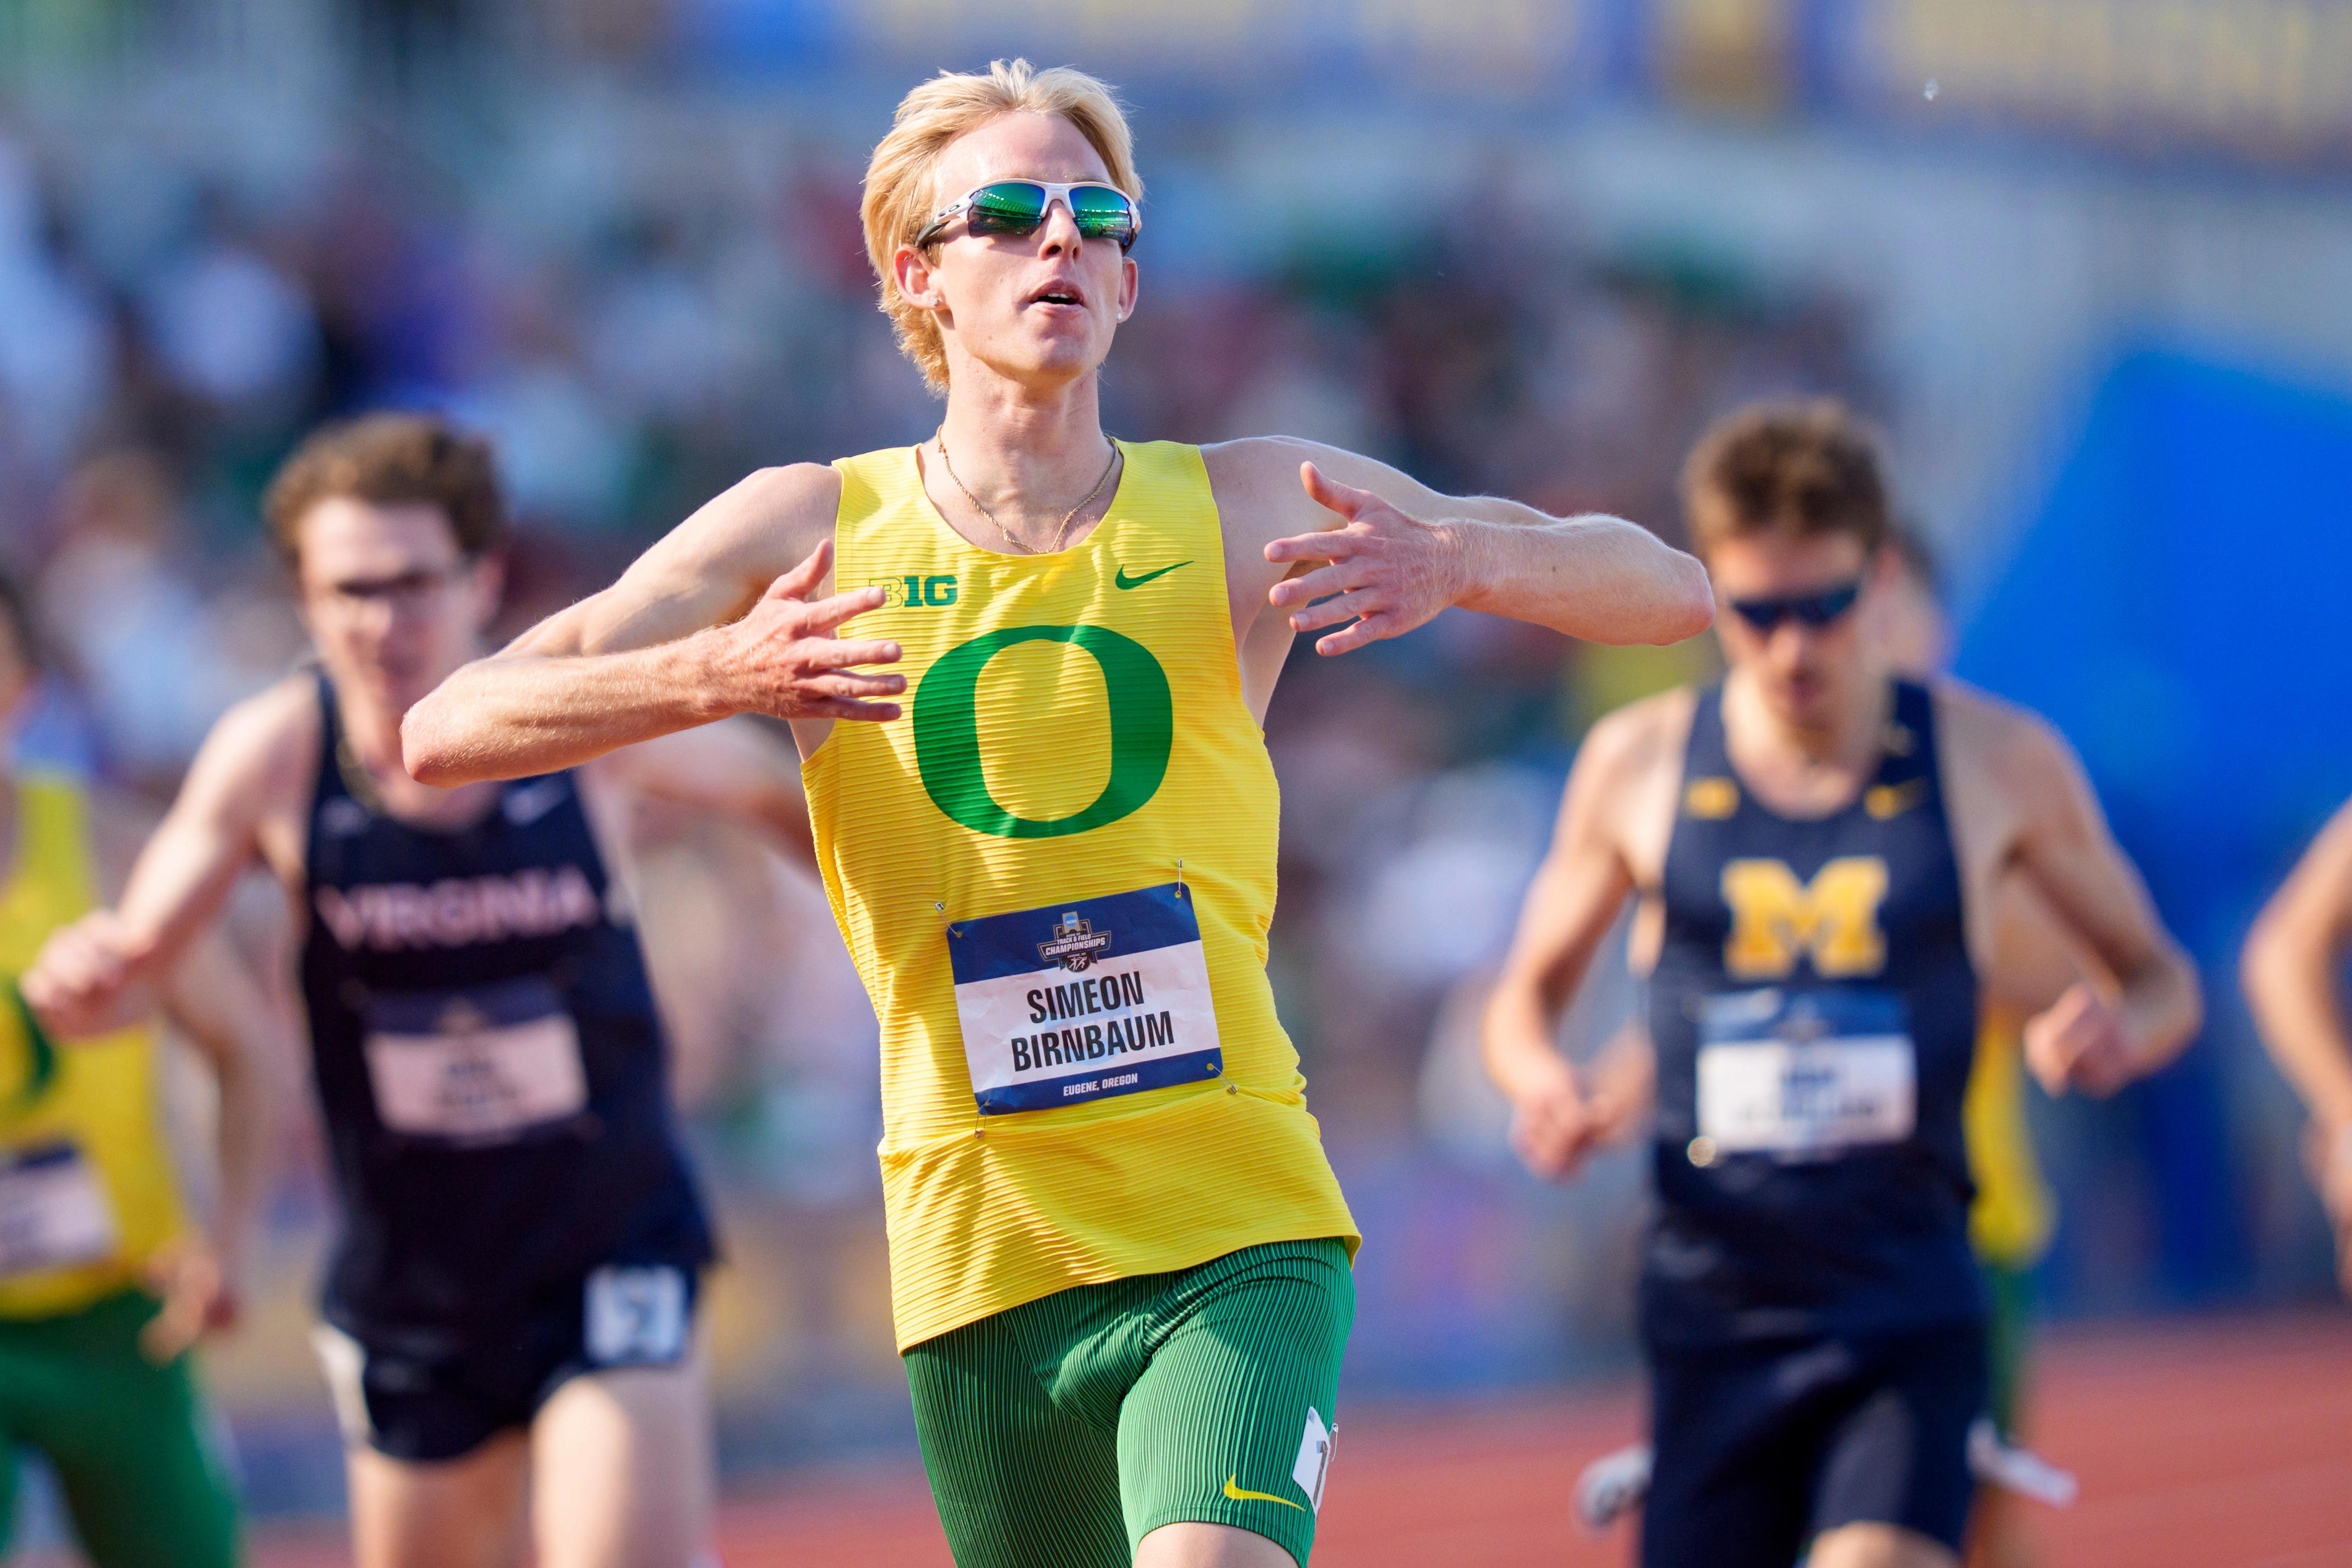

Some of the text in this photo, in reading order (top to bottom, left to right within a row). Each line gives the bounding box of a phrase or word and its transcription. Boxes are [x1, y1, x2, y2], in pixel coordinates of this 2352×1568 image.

[913, 625, 1173, 838] O
[316, 867, 597, 951] VIRGINIA
[1721, 857, 1888, 980] M
[1045, 937, 1106, 956] CHAMPIONSHIPS
[1057, 937, 1073, 945] TRACK
[1027, 971, 1144, 1023] SIMEON
[1011, 1010, 1174, 1072] BIRNBAUM
[1063, 1073, 1138, 1097] EUGENE, OREGON
